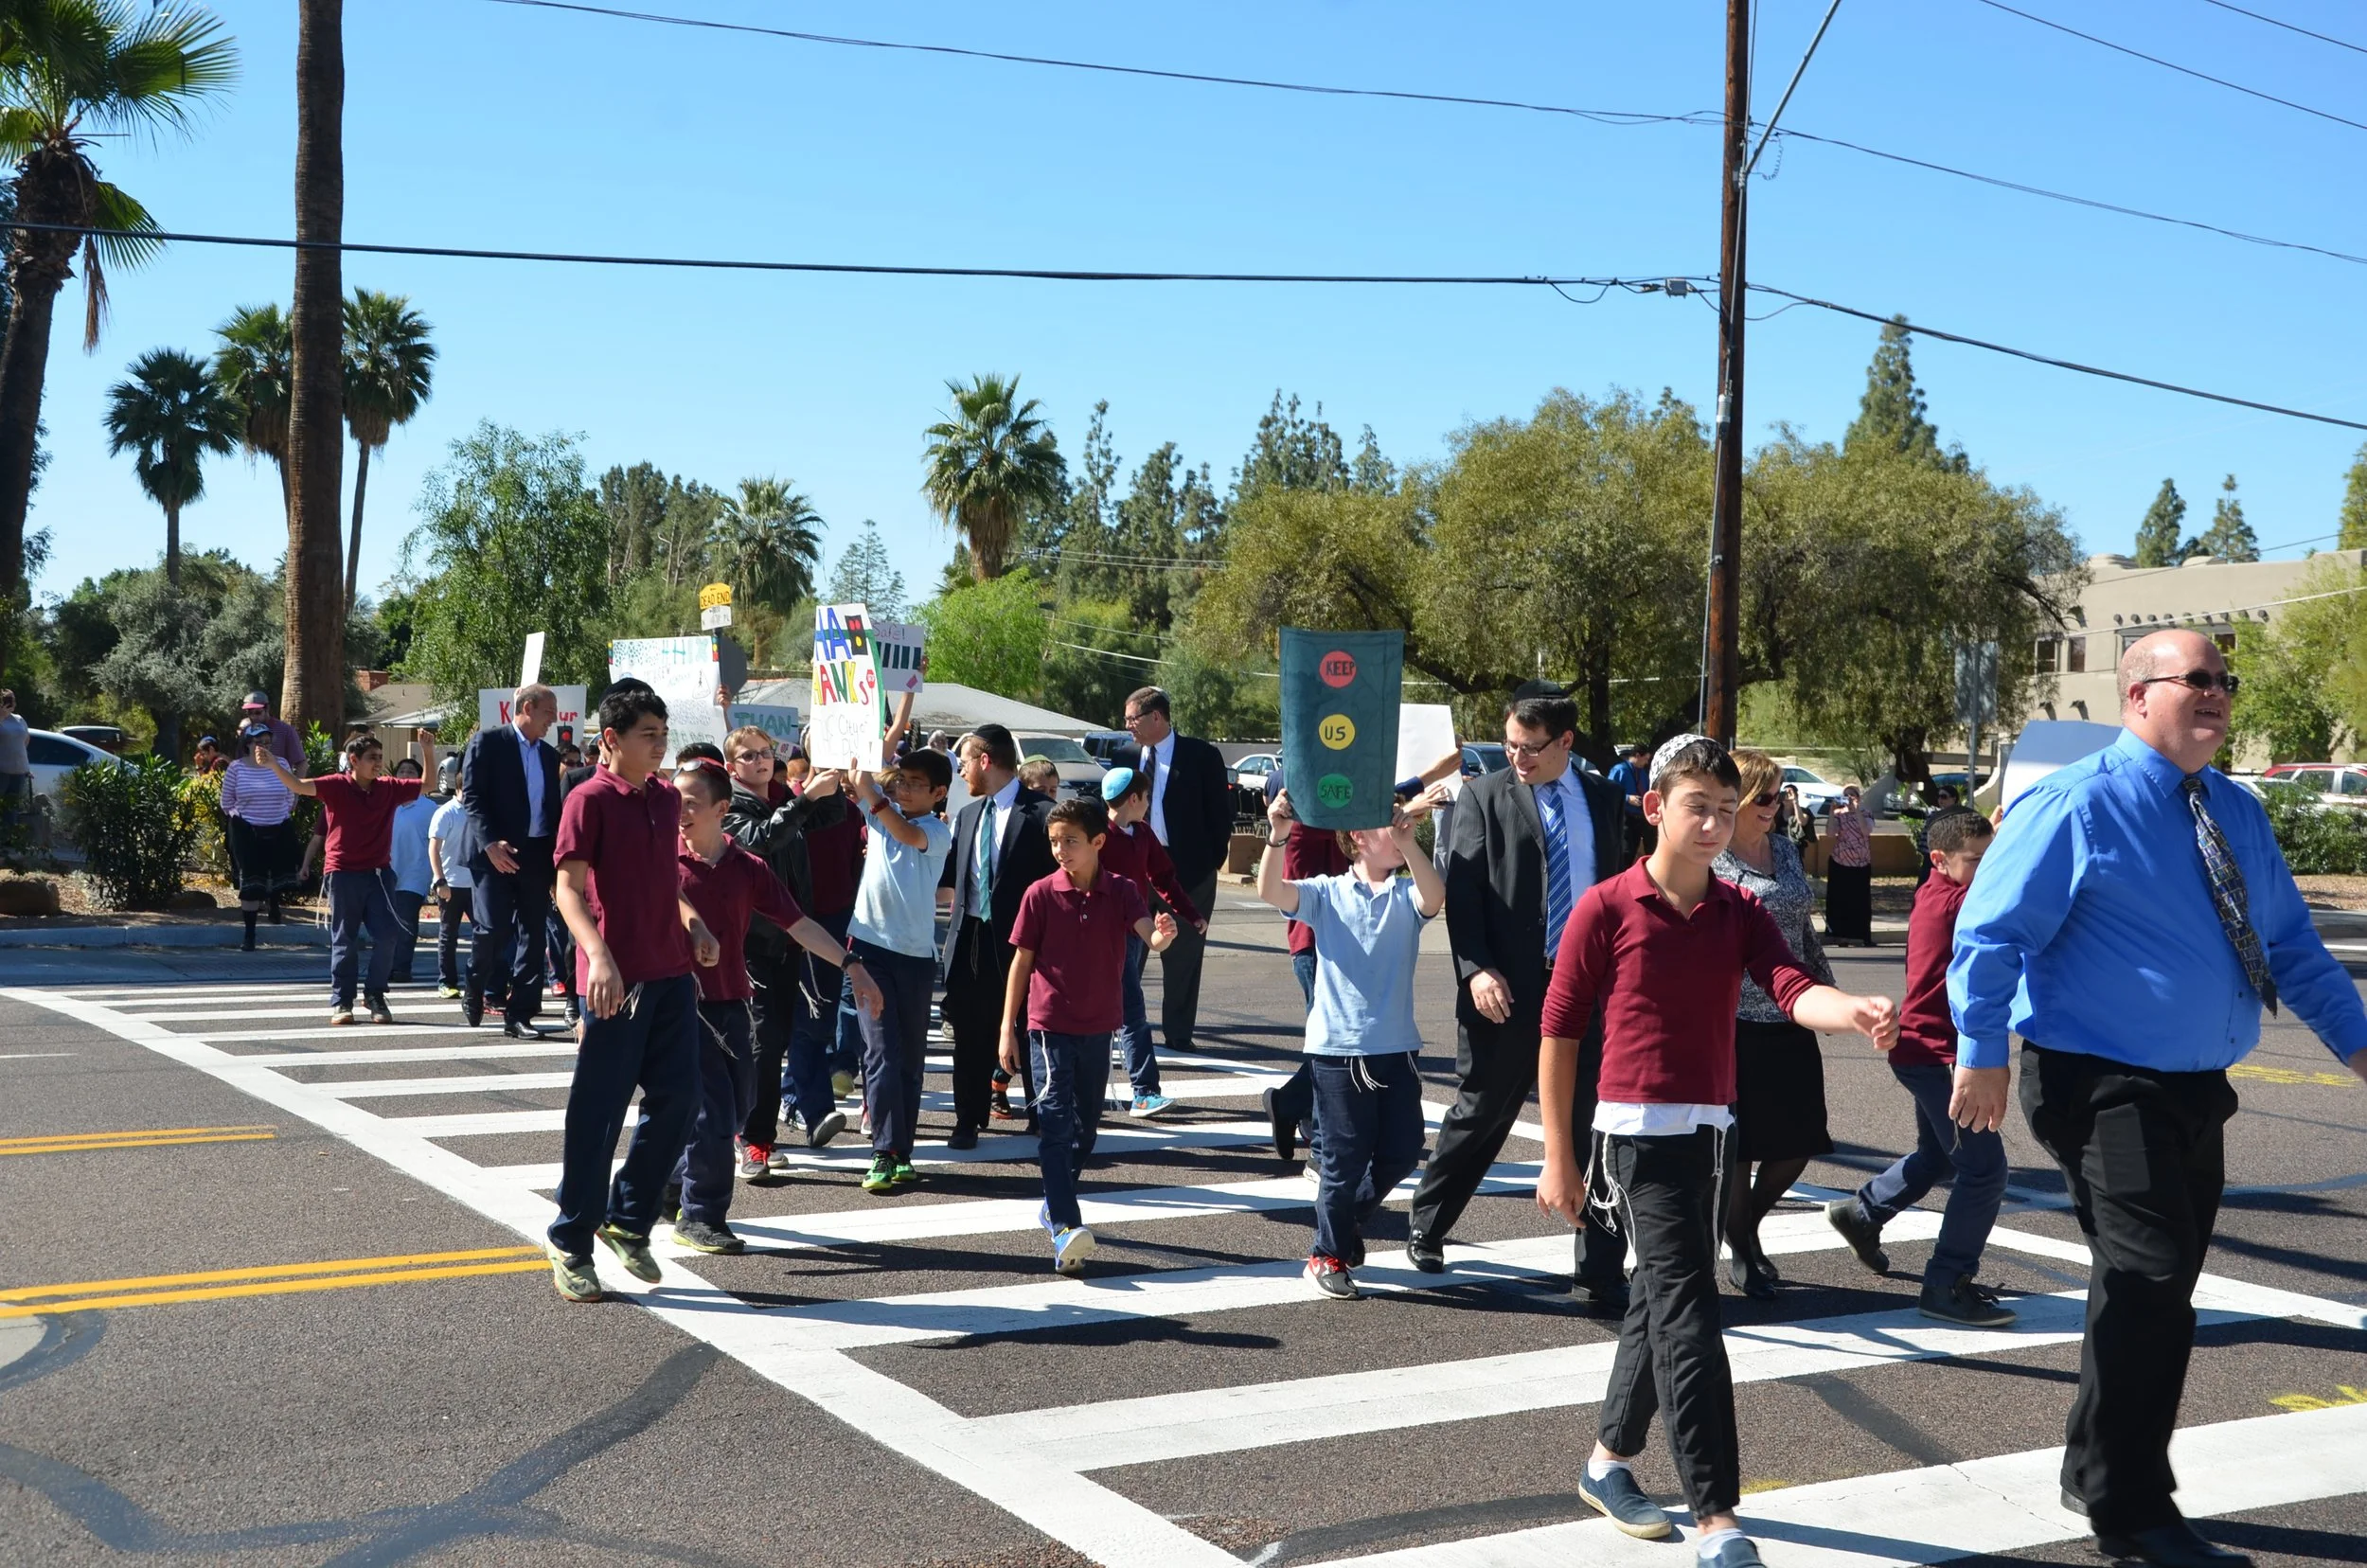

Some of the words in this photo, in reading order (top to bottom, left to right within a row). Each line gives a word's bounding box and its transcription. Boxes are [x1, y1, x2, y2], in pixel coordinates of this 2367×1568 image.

[701, 594, 716, 607] DEAD
[717, 591, 730, 604] END
[1326, 660, 1355, 676] KEEP
[1324, 725, 1346, 741] US
[1321, 783, 1351, 799] SAFE
